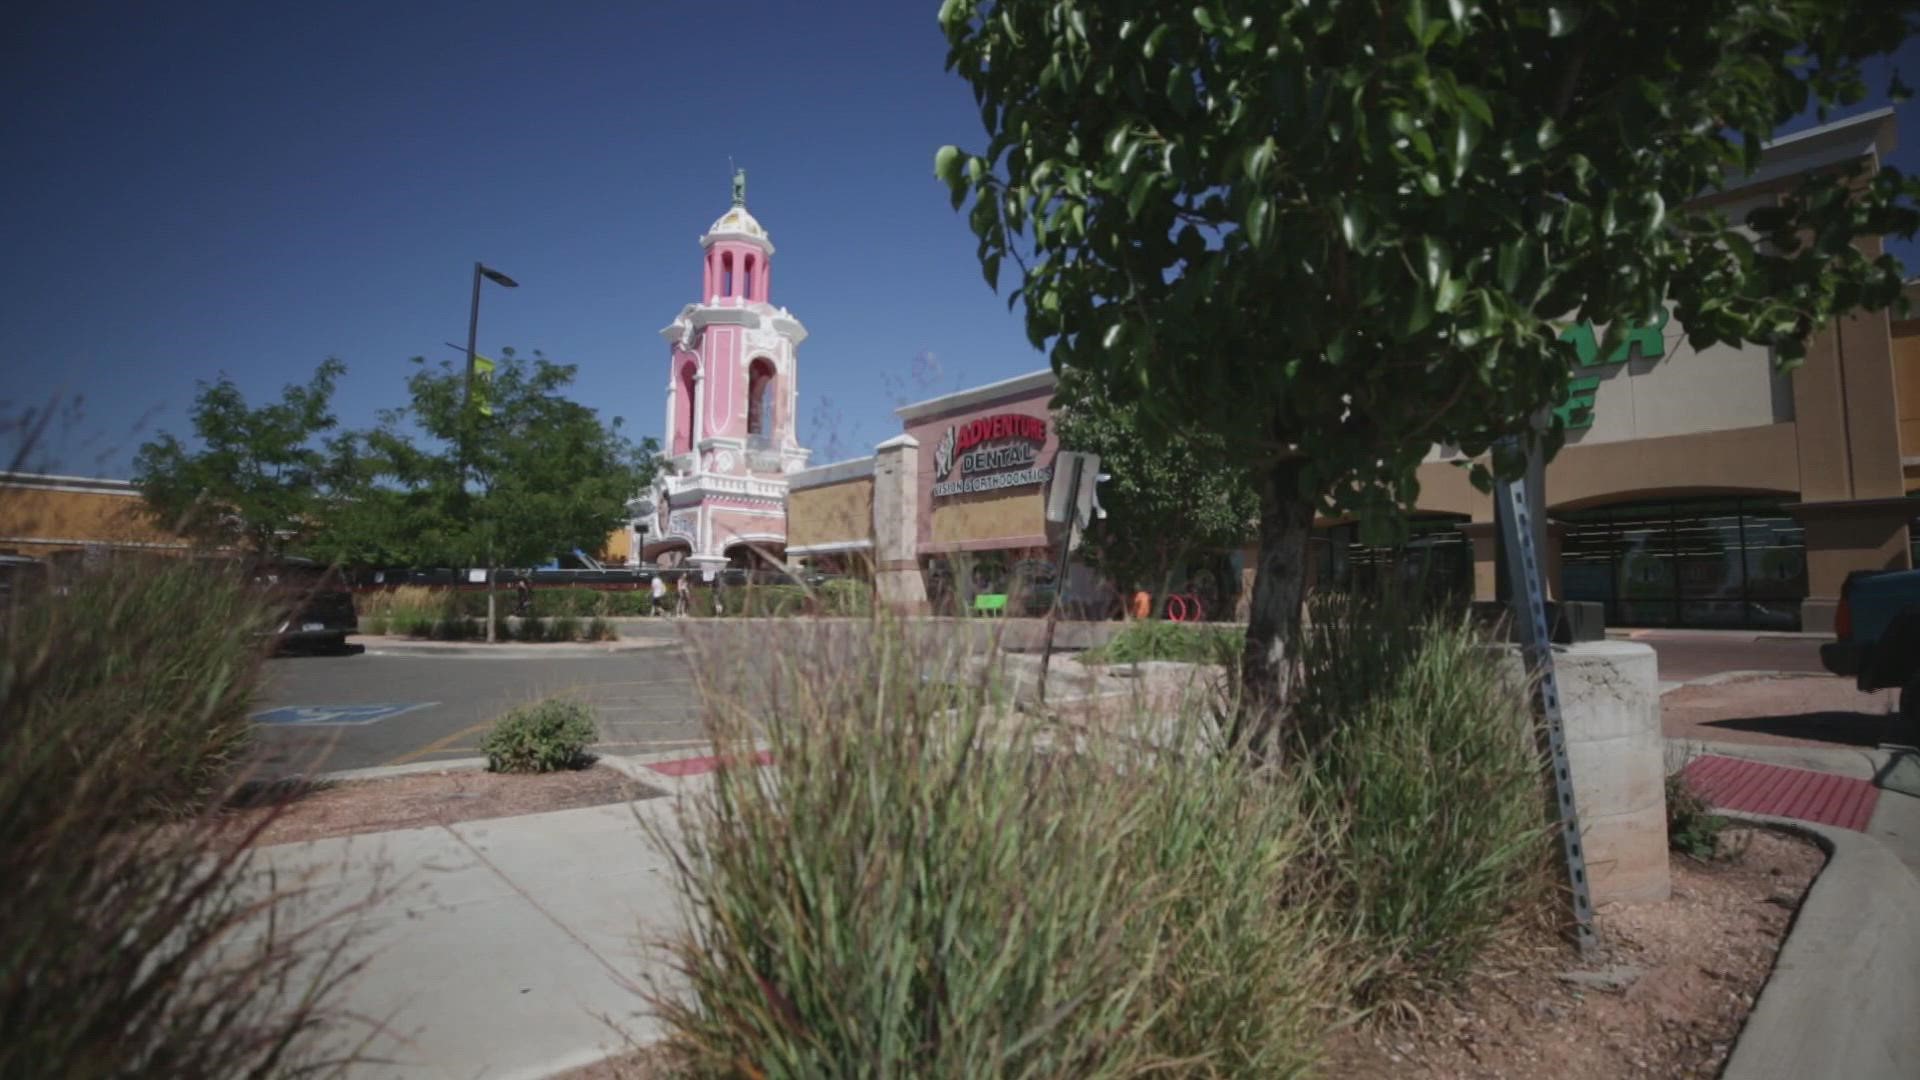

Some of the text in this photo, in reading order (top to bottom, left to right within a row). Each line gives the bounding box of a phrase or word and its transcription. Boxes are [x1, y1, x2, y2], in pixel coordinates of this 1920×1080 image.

[956, 413, 1047, 455] ADVENTURE
[962, 443, 1034, 472] DENTAL
[973, 467, 1052, 491] ORTHODONTICS
